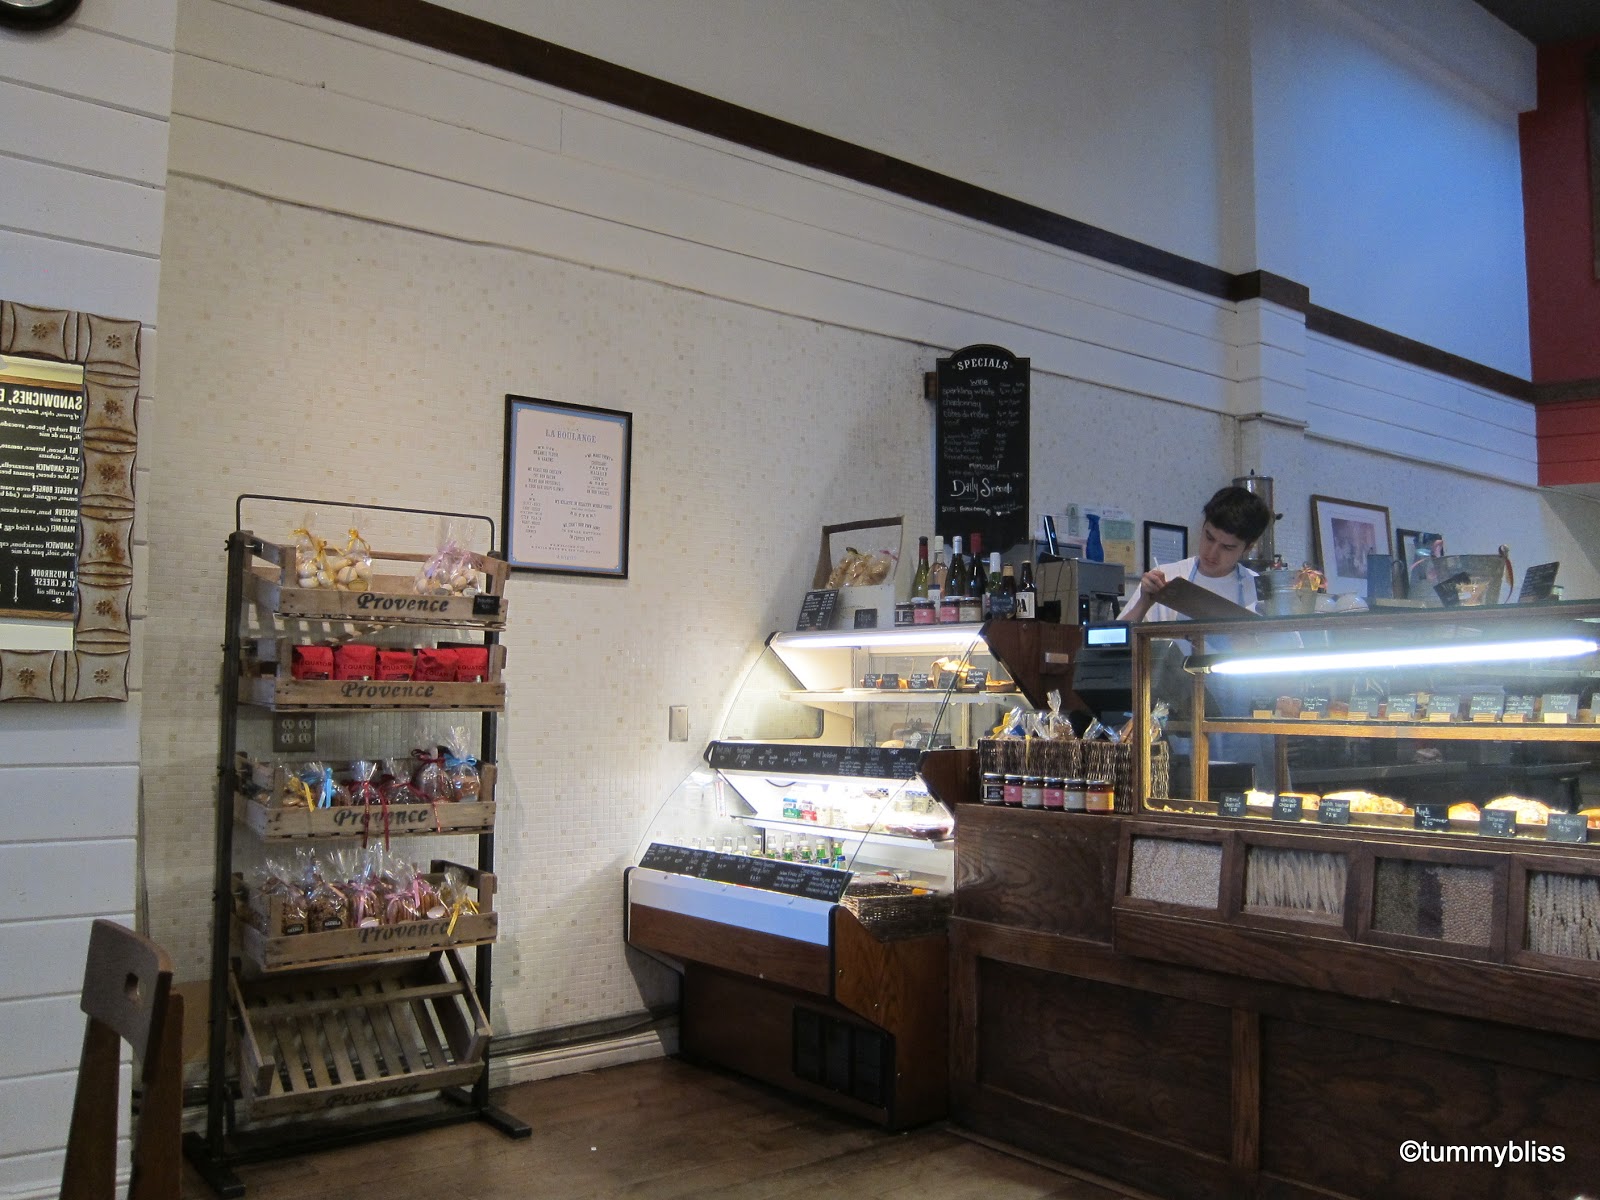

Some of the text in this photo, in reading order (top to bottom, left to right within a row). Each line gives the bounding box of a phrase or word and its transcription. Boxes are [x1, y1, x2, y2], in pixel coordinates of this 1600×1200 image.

[957, 357, 1009, 371] SPECIALS
[545, 428, 597, 444] LA BOULANGE
[950, 476, 1013, 502] Daily Specials
[357, 592, 450, 613] Provence
[340, 682, 434, 699] Provence
[333, 806, 428, 827] Provence
